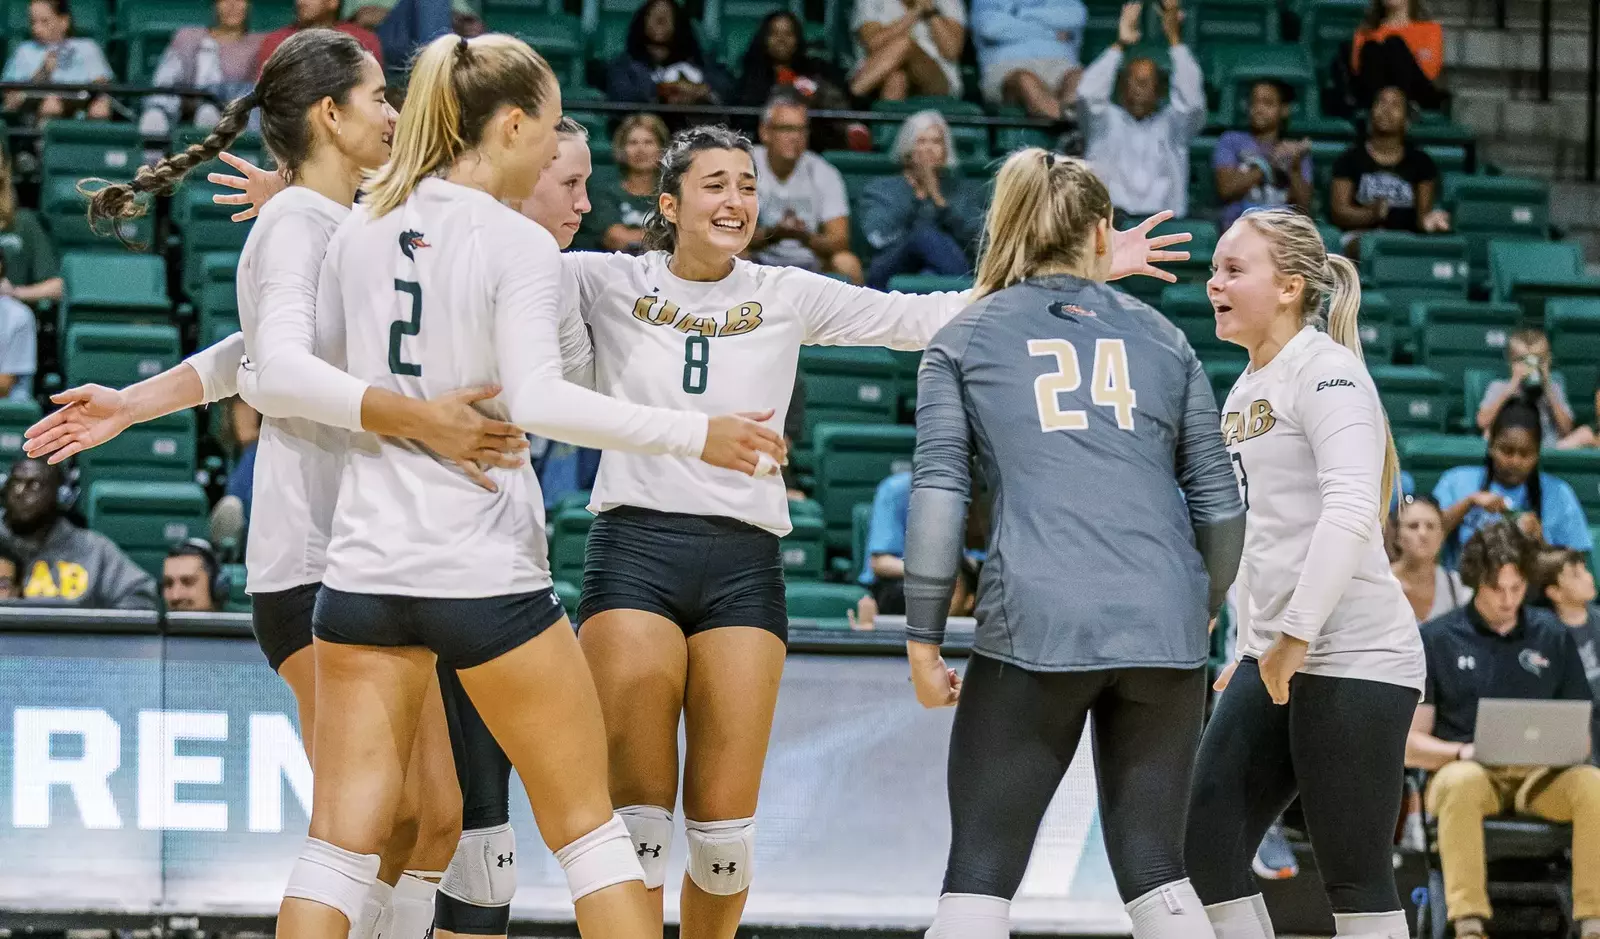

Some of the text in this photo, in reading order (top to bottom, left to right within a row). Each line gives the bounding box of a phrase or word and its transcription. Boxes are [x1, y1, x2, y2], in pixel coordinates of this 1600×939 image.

[388, 278, 422, 377] 2
[631, 295, 764, 338] UAB
[682, 335, 710, 395] 8
[1026, 338, 1137, 433] 24
